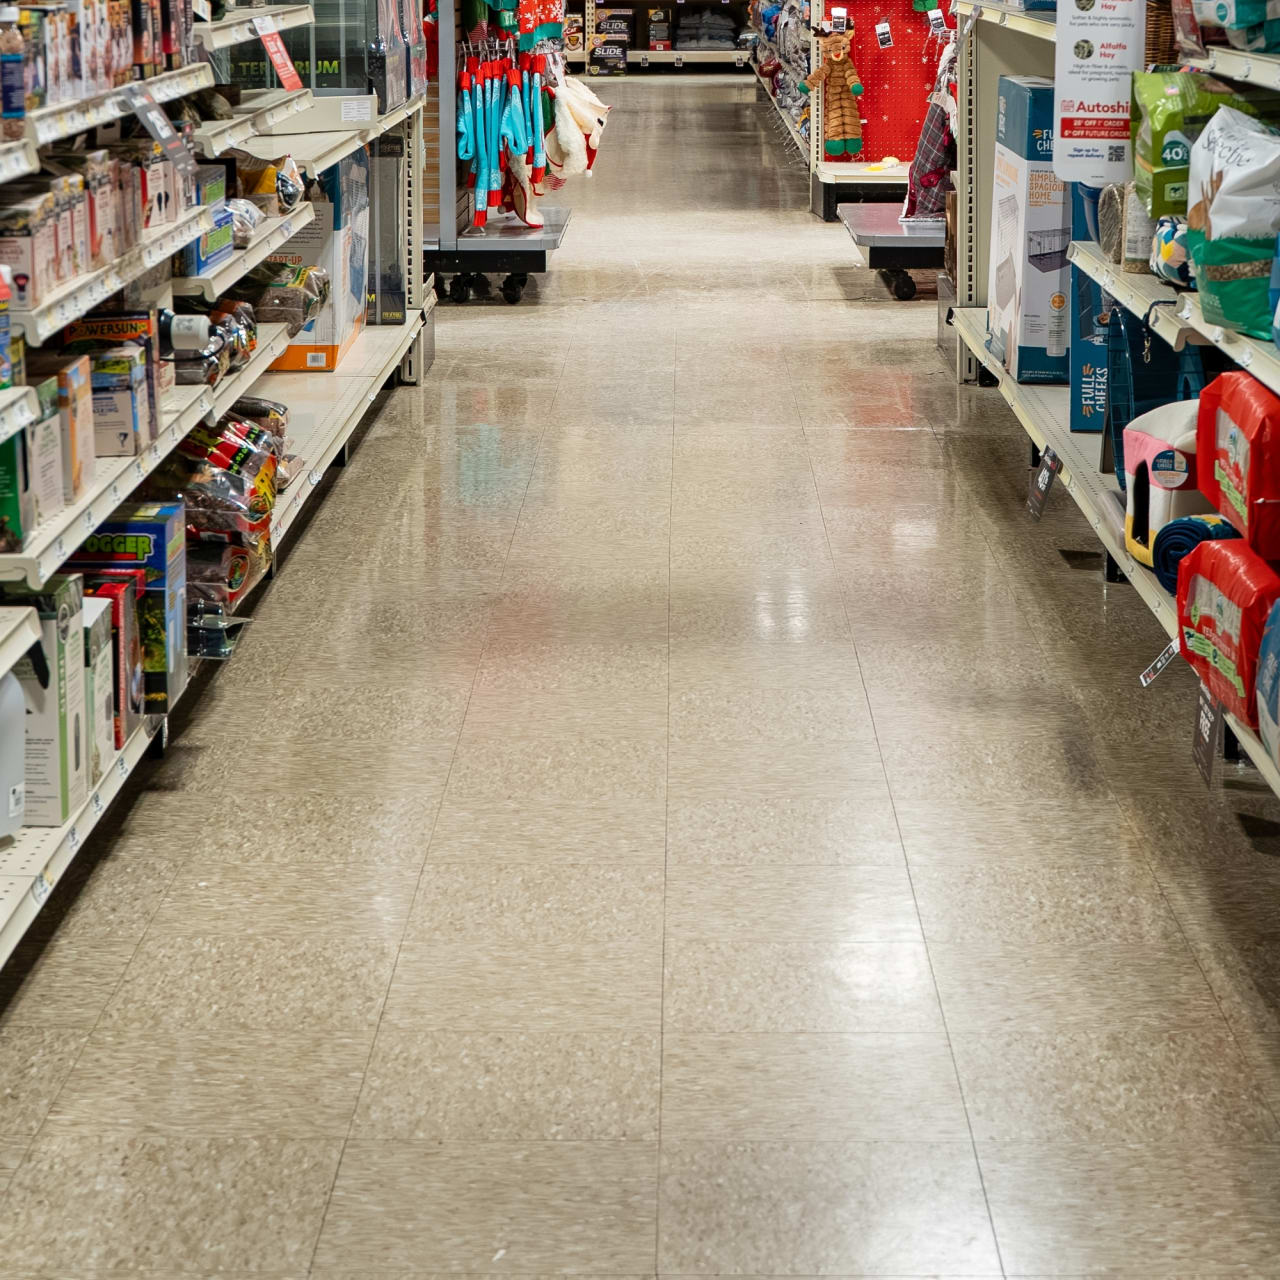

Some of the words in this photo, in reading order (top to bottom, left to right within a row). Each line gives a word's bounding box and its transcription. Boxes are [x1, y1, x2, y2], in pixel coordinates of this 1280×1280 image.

[1101, 3, 1117, 11] Hay
[600, 21, 628, 30] SLIDE
[594, 47, 623, 56] SLIDE
[1076, 101, 1131, 113] Autoshi
[1162, 148, 1182, 160] 40
[1029, 191, 1052, 200] HOME
[266, 255, 303, 265] TART-UP
[69, 322, 139, 337] POWERSUN
[1081, 375, 1095, 405] FULL
[84, 534, 152, 561] OGGER
